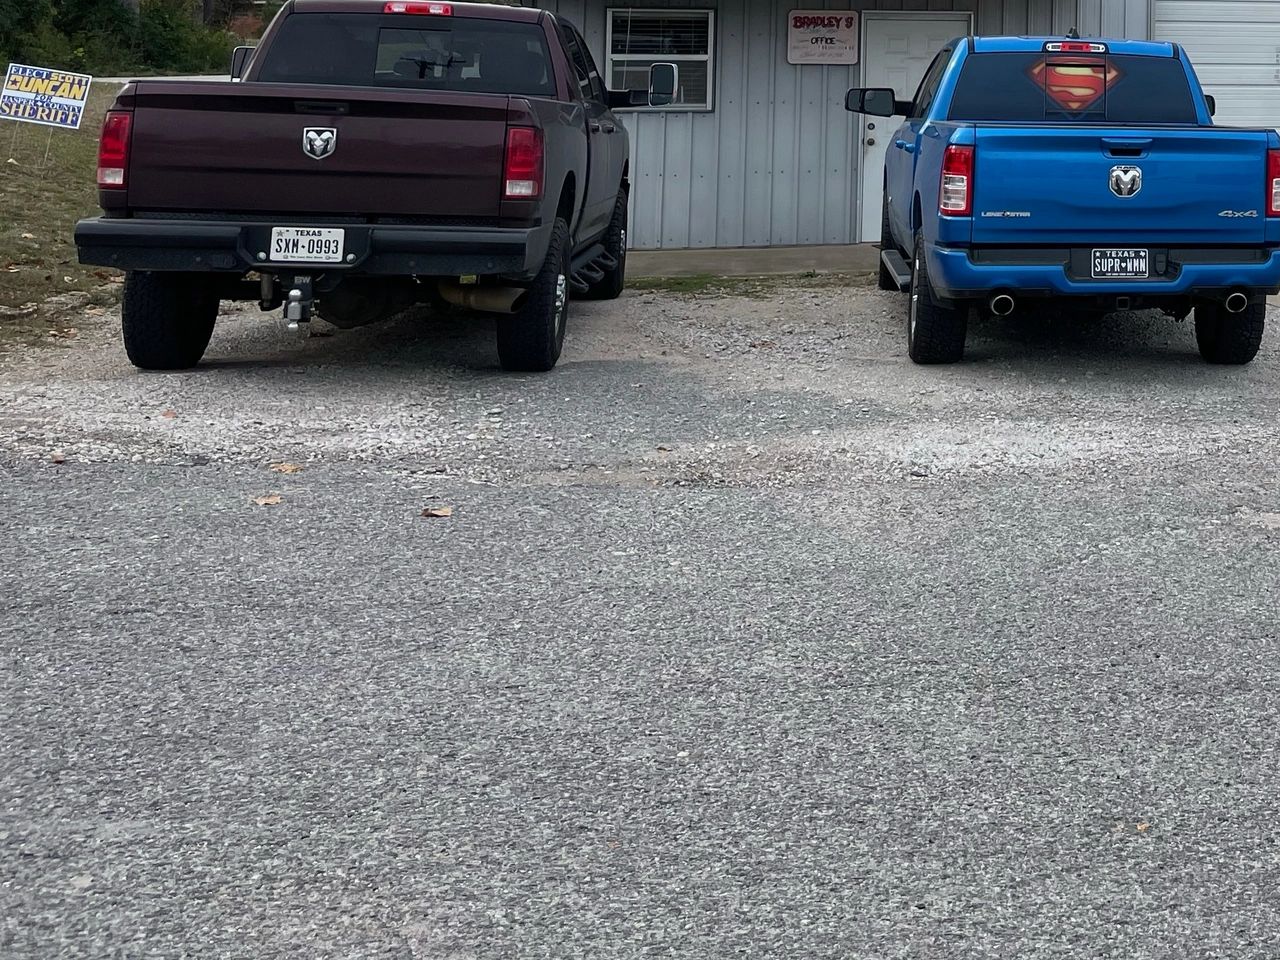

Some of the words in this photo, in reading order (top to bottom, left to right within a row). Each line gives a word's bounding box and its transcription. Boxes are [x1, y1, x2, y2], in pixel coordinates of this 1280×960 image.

[810, 36, 837, 45] OFFICE
[11, 66, 50, 79] ELECT
[50, 72, 89, 85] SCOTT
[6, 74, 86, 100] DUNCAN
[34, 93, 53, 103] FOR
[2, 95, 35, 107] JASPER
[43, 101, 81, 113] COUNTY
[0, 101, 80, 125] SHERIFF
[1218, 210, 1259, 218] 4x4
[294, 229, 323, 237] TEXAS
[1105, 250, 1135, 258] TEXAS
